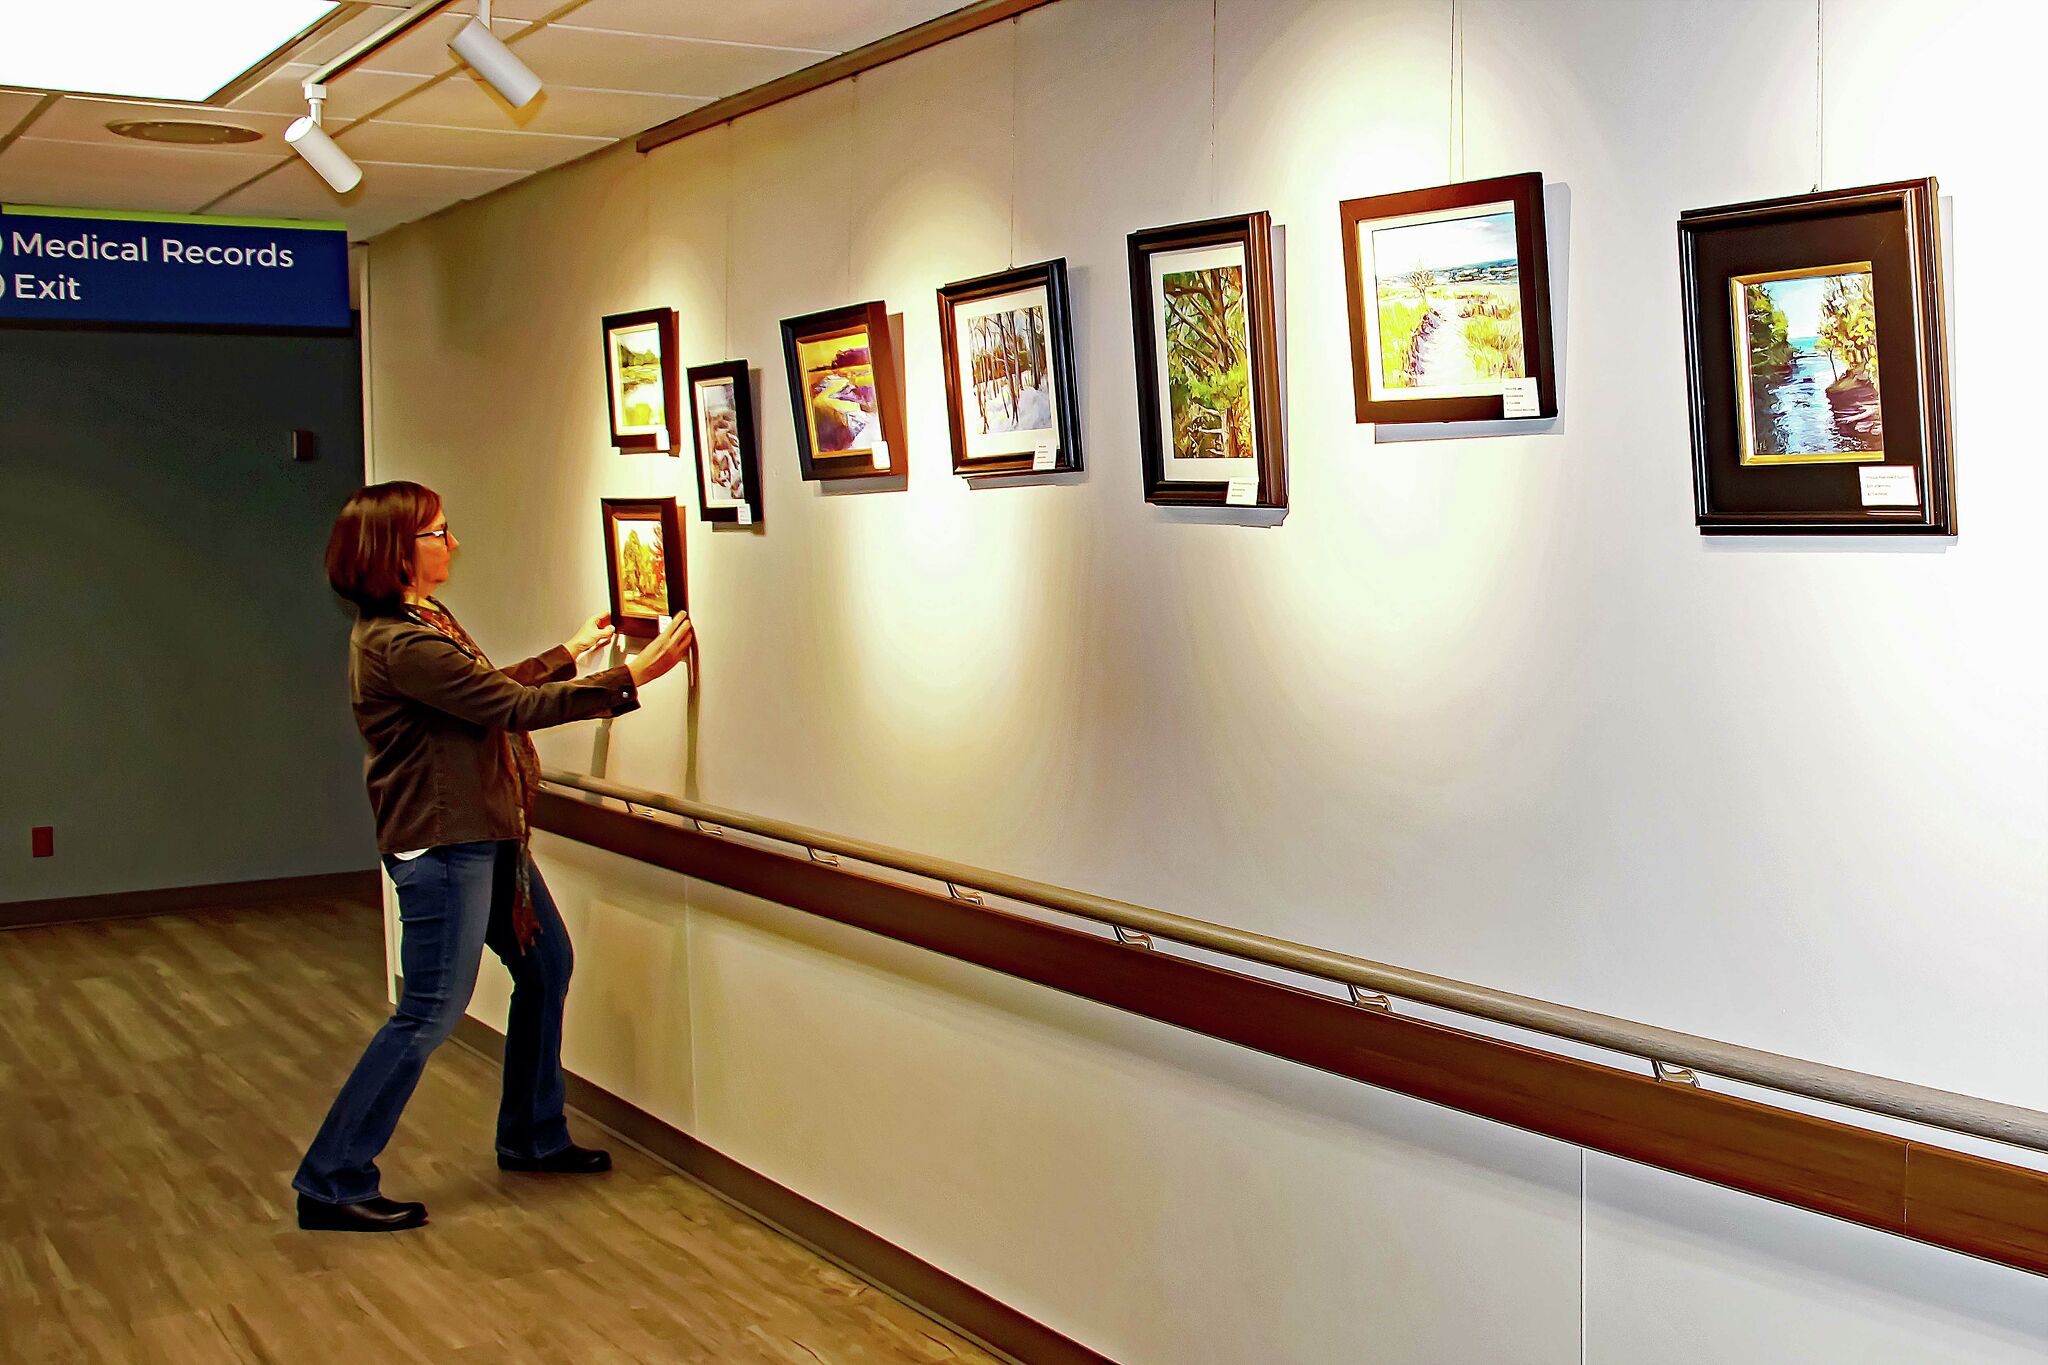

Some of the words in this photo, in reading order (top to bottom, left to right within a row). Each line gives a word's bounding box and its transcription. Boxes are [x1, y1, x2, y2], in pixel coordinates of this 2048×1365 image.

[12, 231, 147, 261] Medical
[161, 238, 295, 267] Records
[14, 273, 81, 300] Exit
